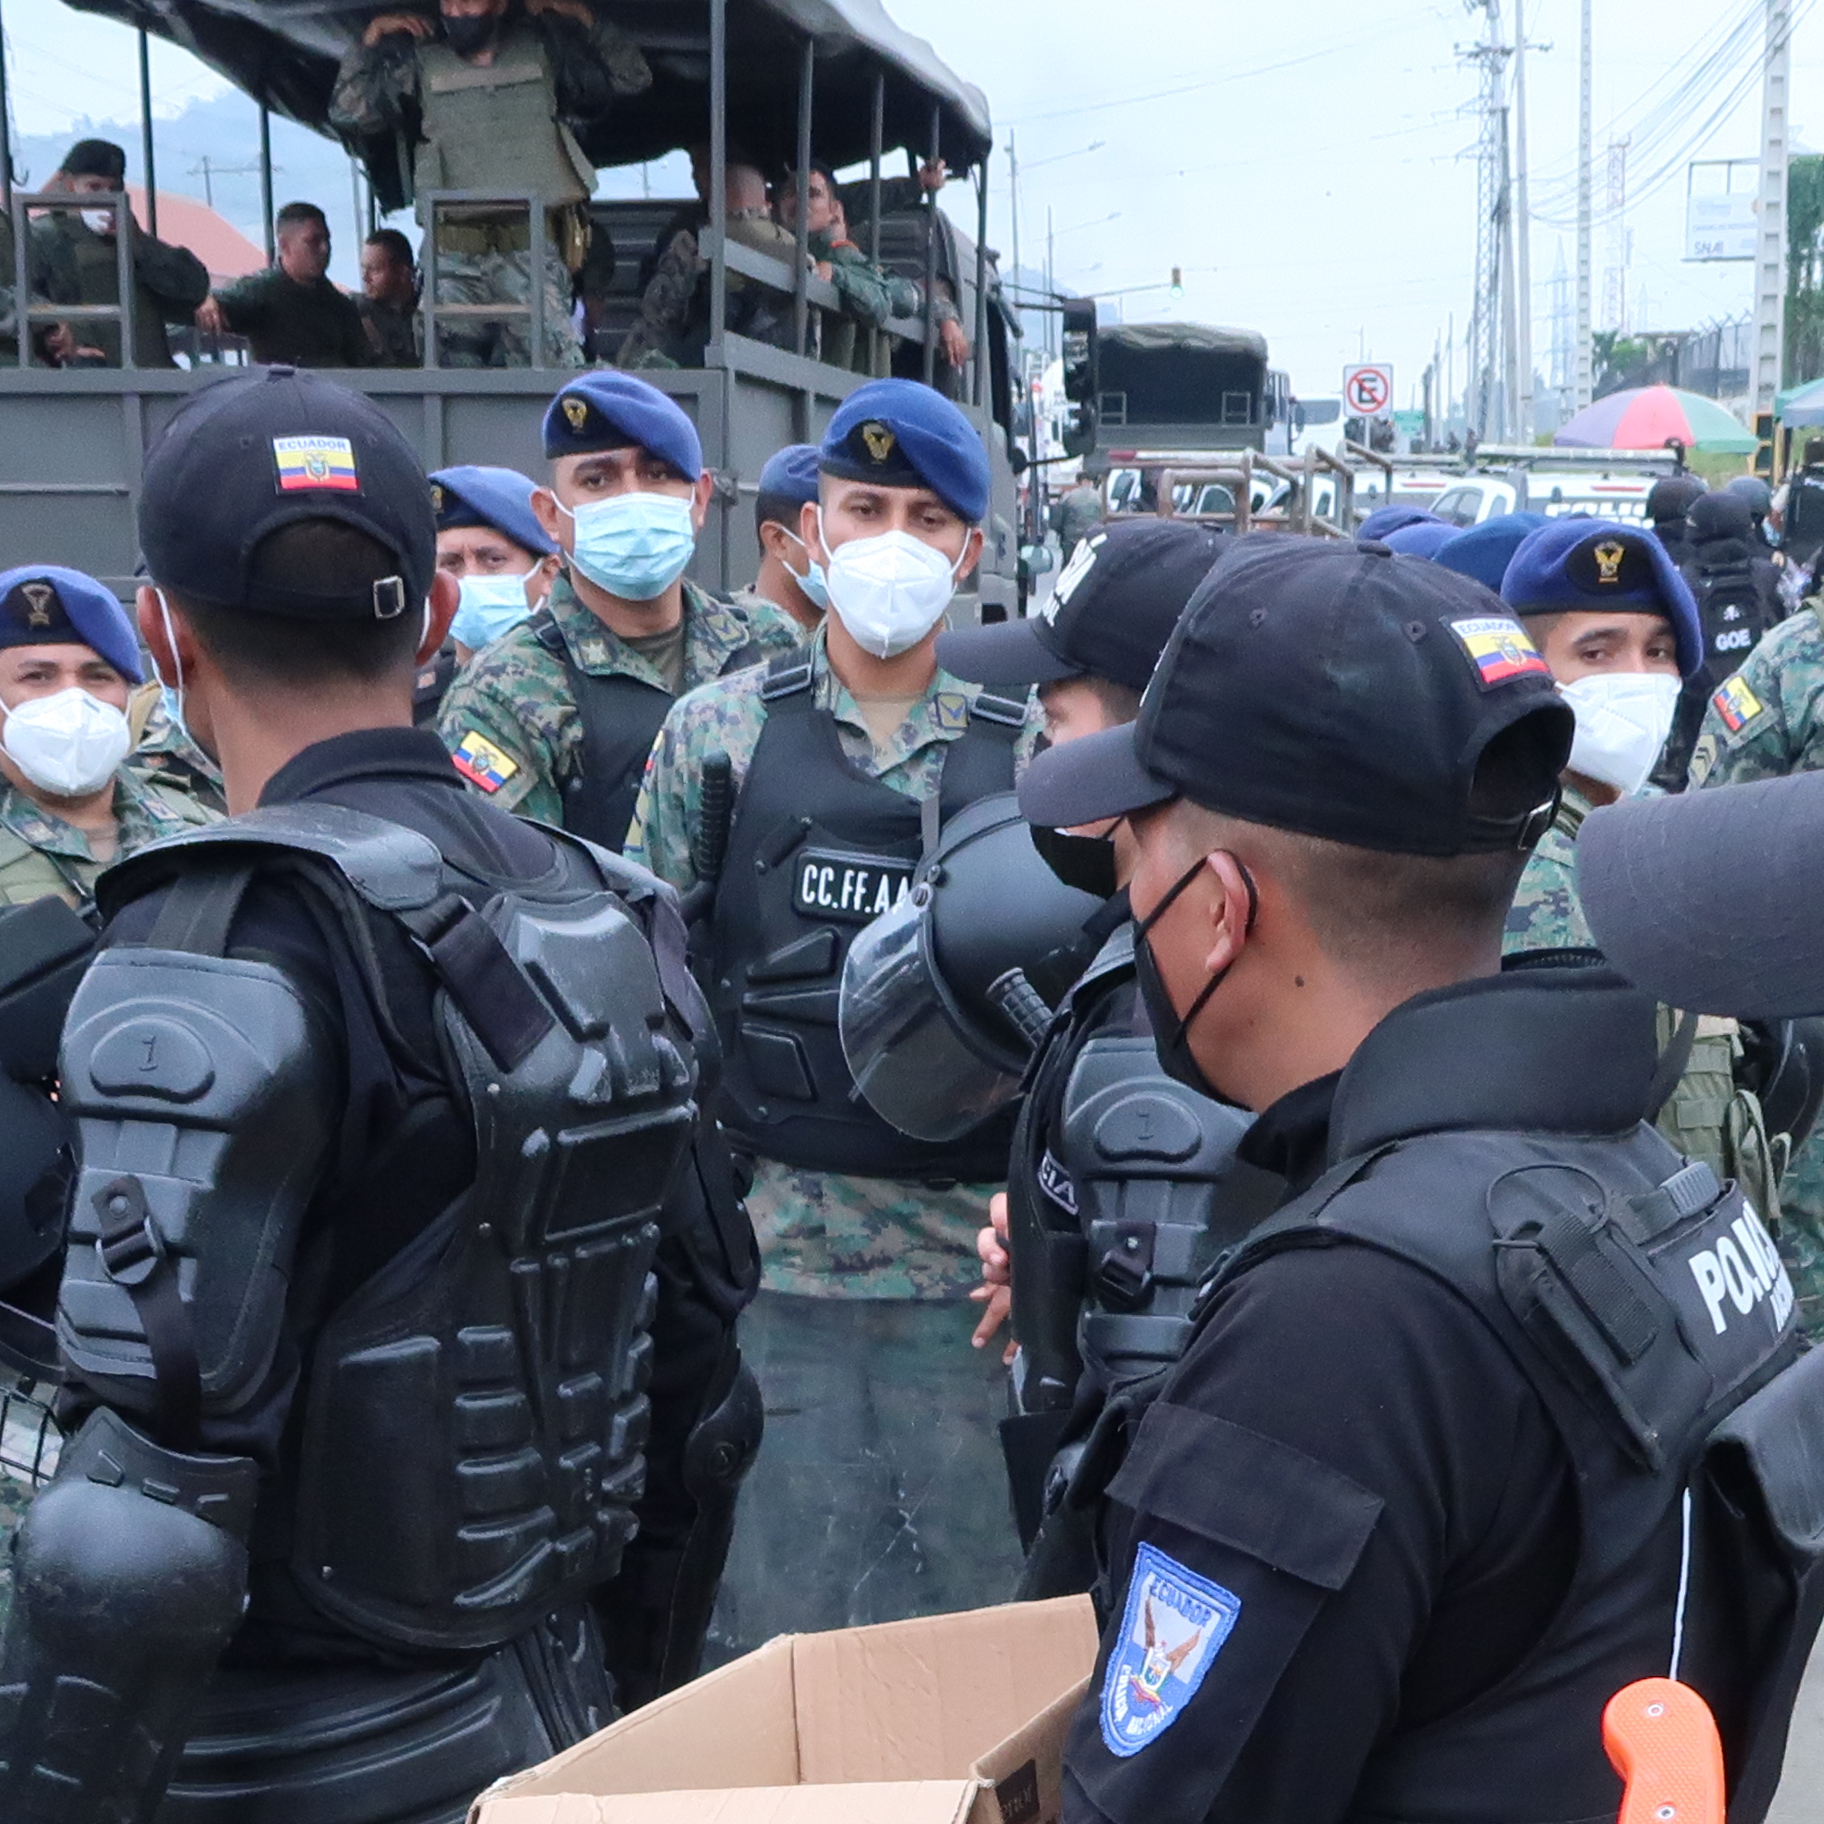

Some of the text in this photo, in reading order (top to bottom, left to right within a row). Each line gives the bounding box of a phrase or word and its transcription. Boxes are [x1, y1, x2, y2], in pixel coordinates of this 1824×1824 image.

[278, 439, 346, 451] ECUADOR
[1716, 628, 1752, 651] GOE
[1149, 1577, 1213, 1628] ECUADOR
